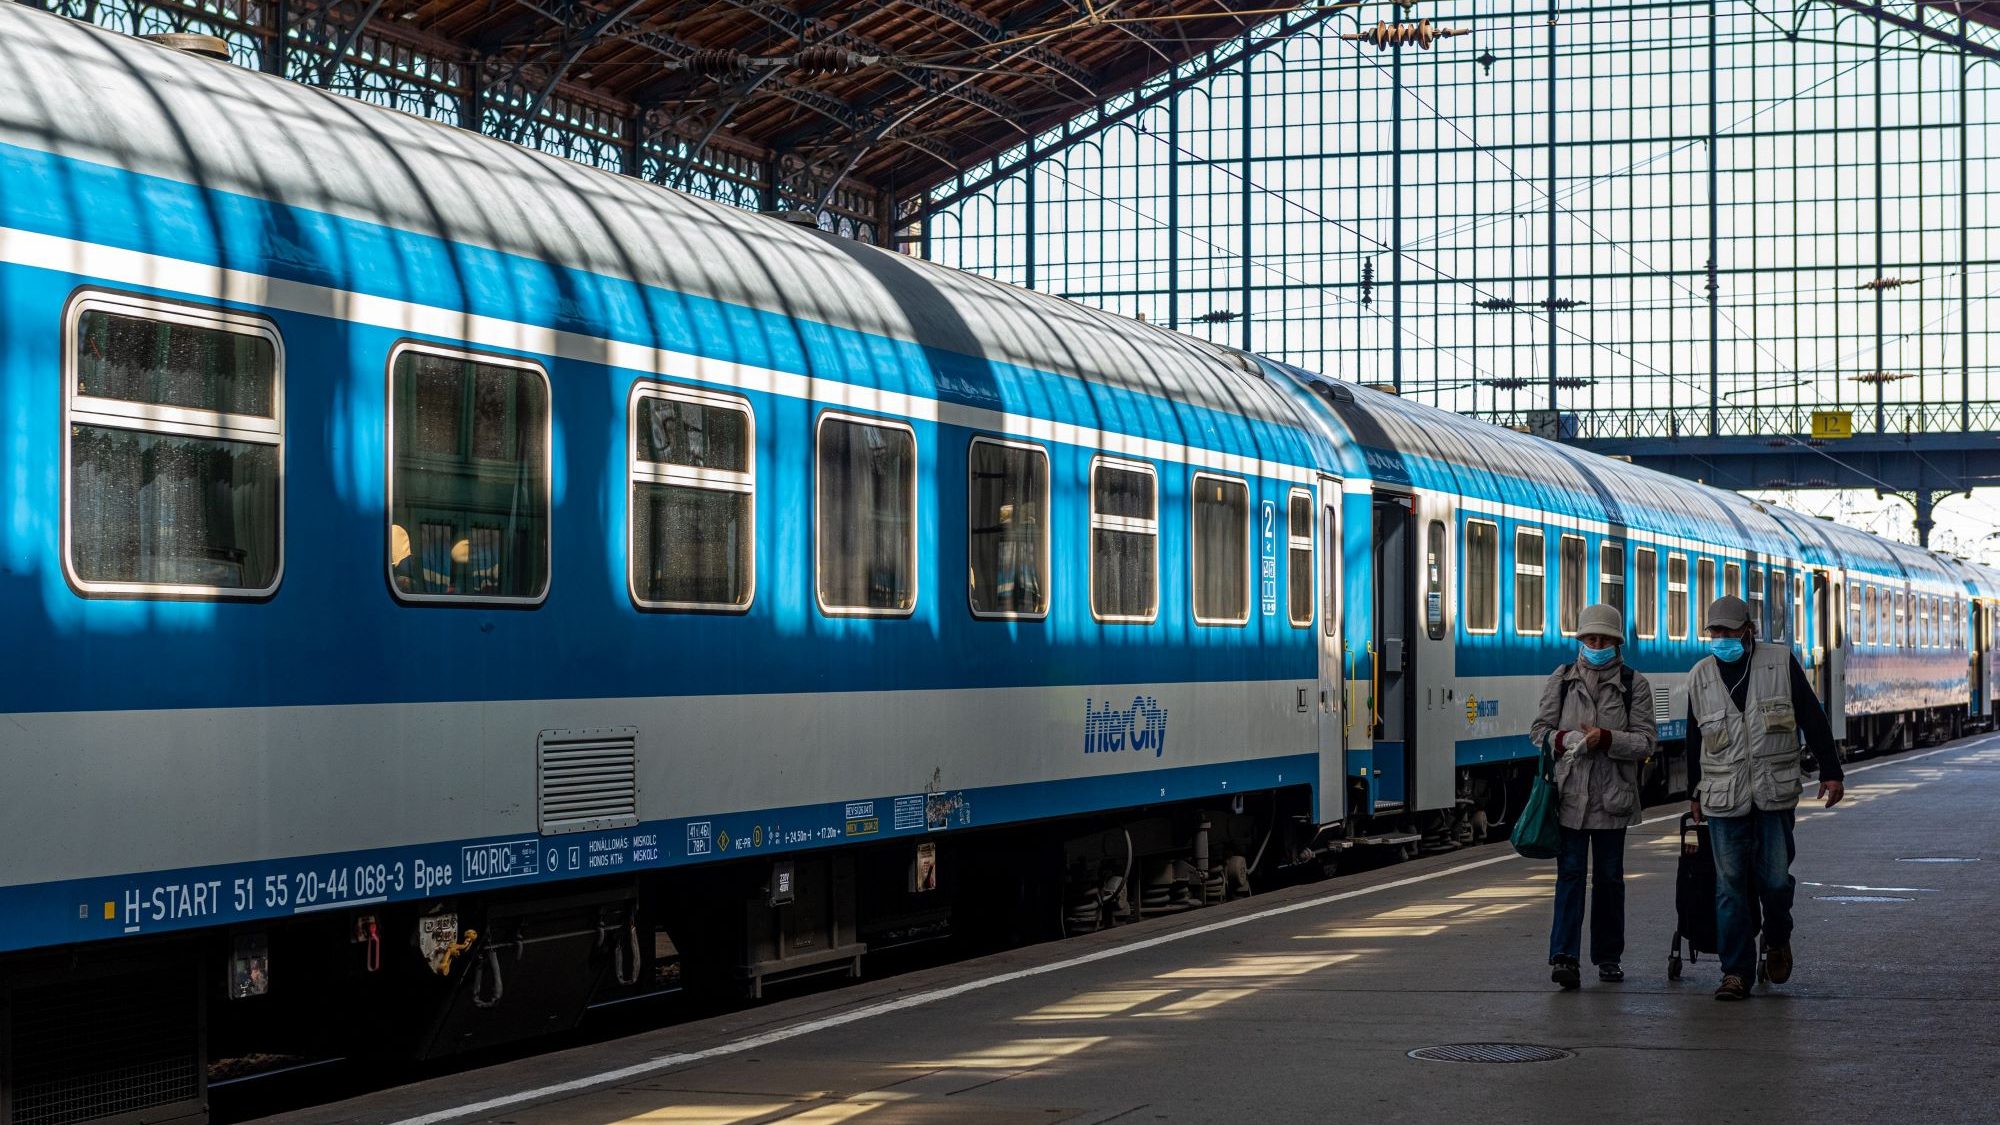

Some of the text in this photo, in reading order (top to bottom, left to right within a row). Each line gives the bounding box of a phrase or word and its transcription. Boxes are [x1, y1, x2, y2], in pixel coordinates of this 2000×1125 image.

[1824, 416, 1840, 432] 12
[1265, 505, 1272, 538] 2
[1084, 696, 1167, 757] InterCity
[633, 834, 657, 847] MISKOLC
[466, 849, 488, 877] 140
[490, 847, 510, 874] RIC
[589, 854, 609, 868] HONOS
[633, 848, 658, 862] MISKOLC
[125, 859, 452, 924] H-START 51 55 20-44 068-3 Bpee
